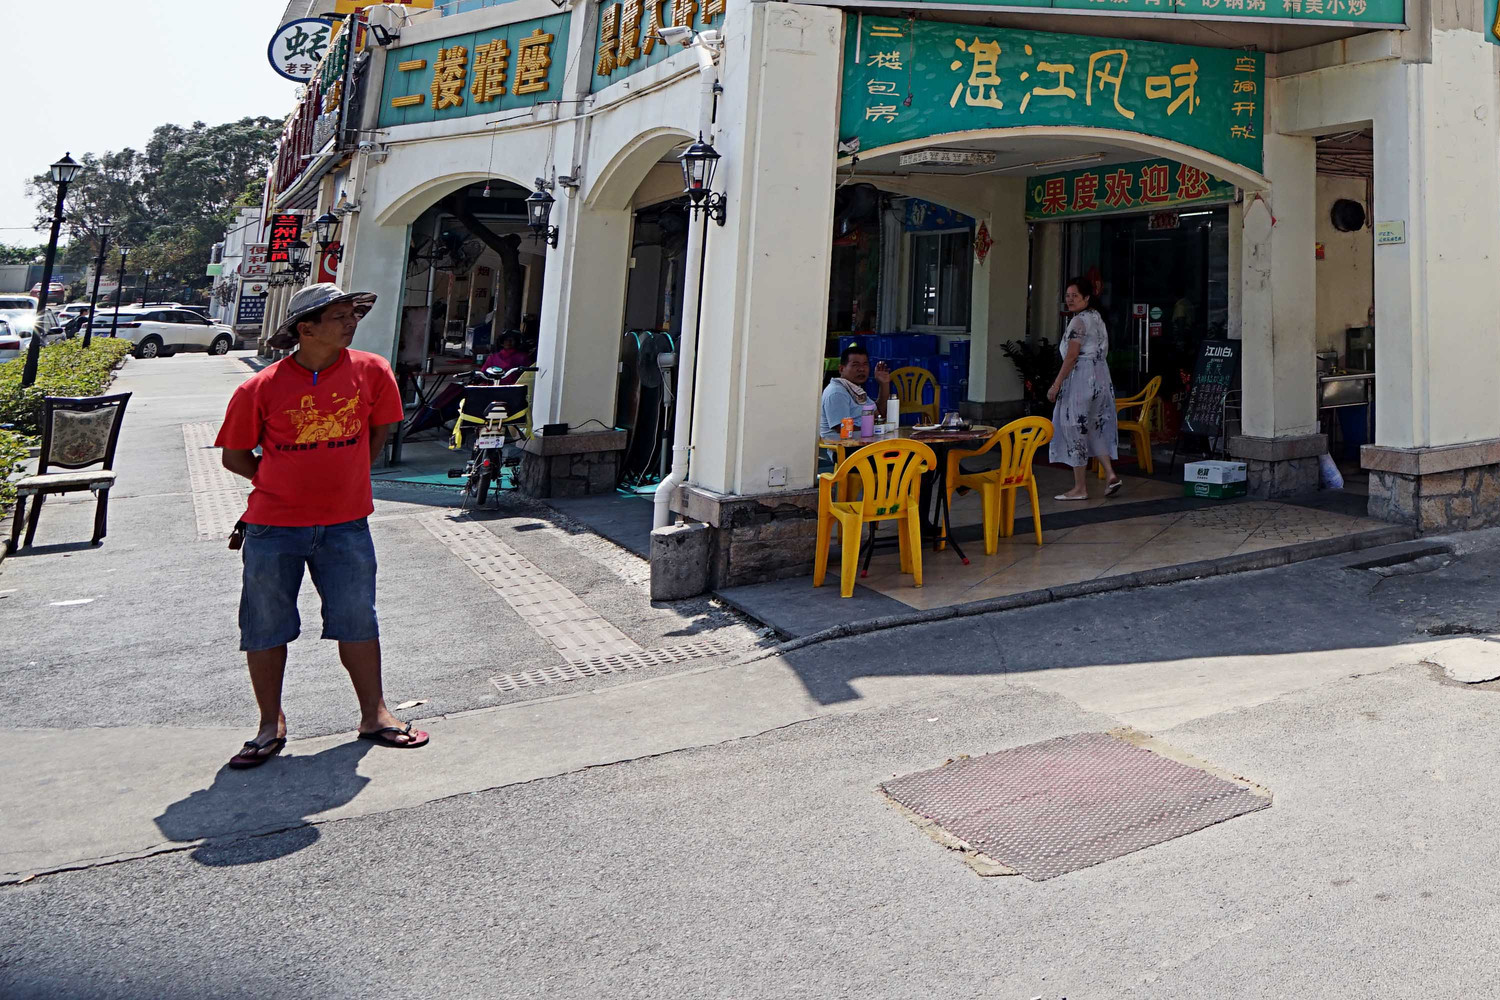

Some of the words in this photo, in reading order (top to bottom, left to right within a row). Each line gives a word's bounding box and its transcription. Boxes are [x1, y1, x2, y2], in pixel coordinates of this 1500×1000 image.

[284, 25, 329, 62] 蚝
[285, 62, 319, 75] 老字
[391, 27, 555, 111] 二楼雅座
[864, 26, 903, 123] 二楼包房
[949, 36, 1201, 120] 湛江风味
[1230, 56, 1256, 139] 空调开放
[1041, 162, 1211, 215] 果度欢迎您
[1204, 345, 1234, 359] 江小白
